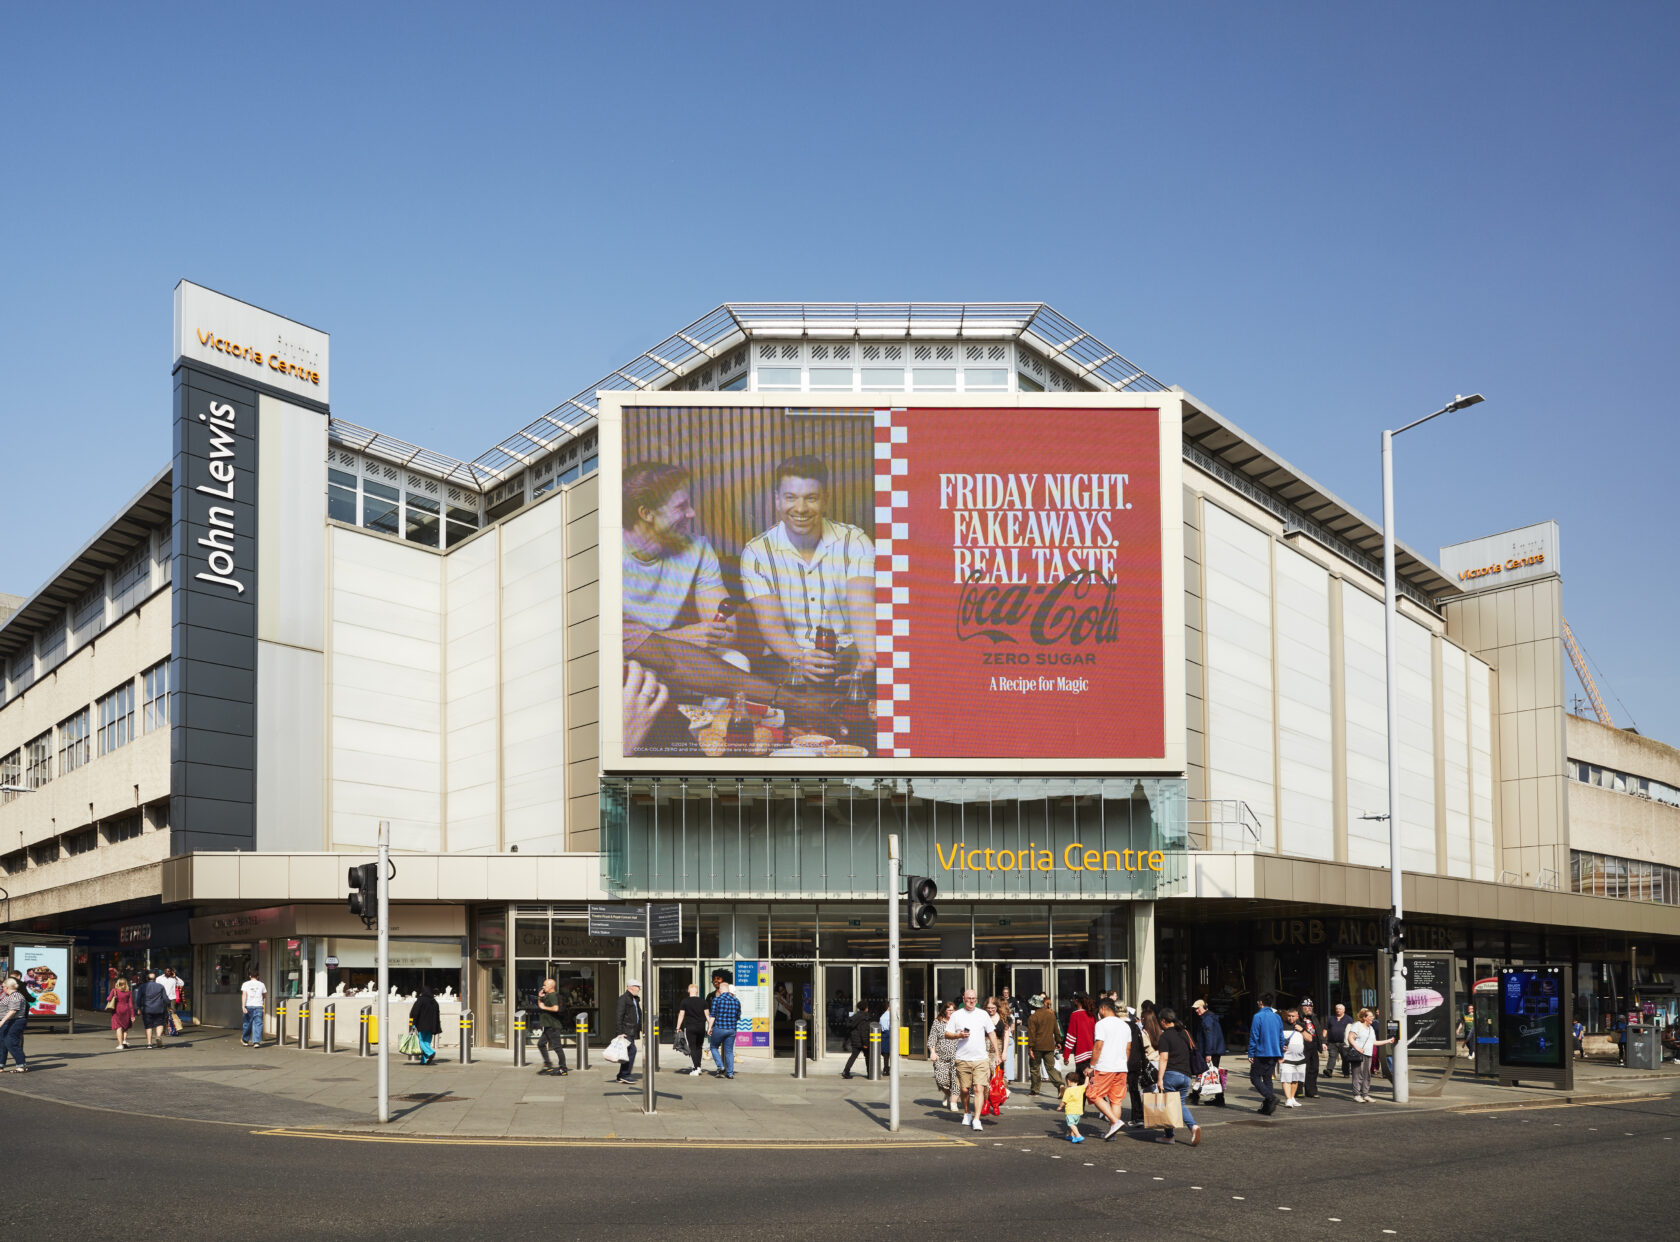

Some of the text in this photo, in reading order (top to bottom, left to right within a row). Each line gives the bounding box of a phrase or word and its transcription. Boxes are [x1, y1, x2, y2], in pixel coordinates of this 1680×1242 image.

[197, 327, 320, 386] Victoria Centre
[194, 400, 245, 594] John Lewis
[939, 473, 1133, 510] FRIDAY NIGHT.
[953, 511, 1120, 547] FAKEAWAYS.
[953, 548, 1118, 584] REAL TASTE
[1458, 553, 1545, 581] Victoria Centre
[956, 569, 1120, 646] Coca-Cola
[982, 652, 1096, 665] ZERO SUGAR
[989, 676, 1089, 694] A Recipe for Magic
[936, 842, 1165, 872] Victoria Centre
[119, 923, 152, 943] BETFRED
